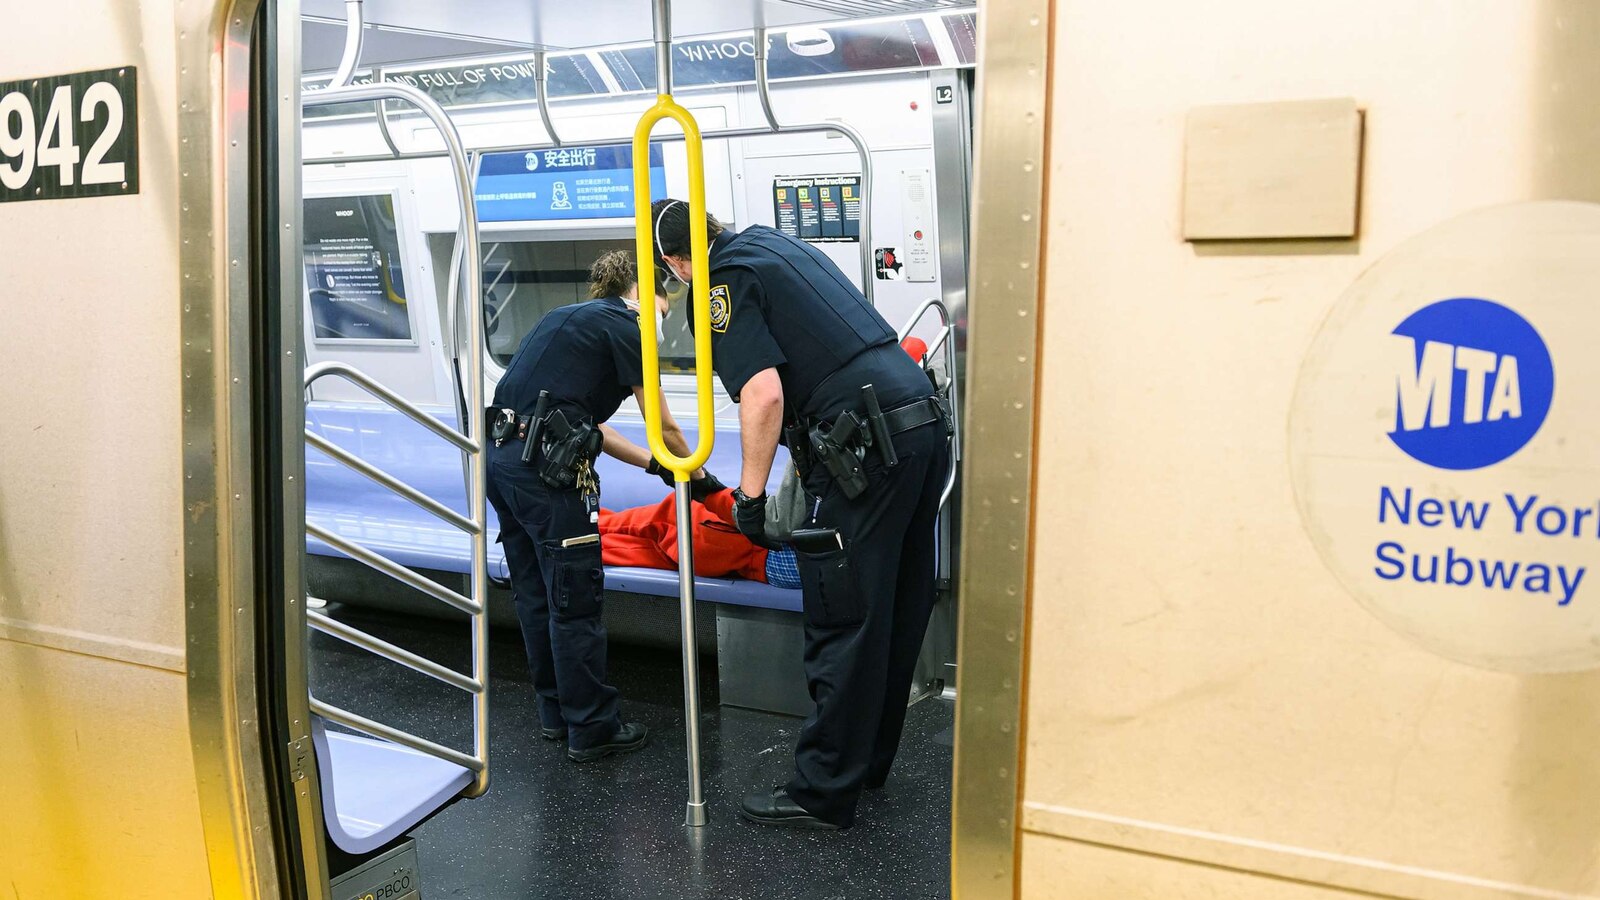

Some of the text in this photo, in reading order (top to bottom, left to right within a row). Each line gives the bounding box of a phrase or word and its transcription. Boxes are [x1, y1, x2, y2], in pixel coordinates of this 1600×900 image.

[679, 39, 772, 61] WHOO
[419, 72, 464, 88] FULL
[463, 69, 487, 83] OF
[937, 89, 952, 101] L2
[0, 81, 126, 190] 942
[544, 149, 596, 168] 安全出行
[776, 177, 857, 188] Emergency Instructions
[1385, 332, 1523, 434] MTA
[1378, 486, 1600, 539] New Yor
[1374, 541, 1586, 606] Subway
[376, 875, 410, 900] PBCO
